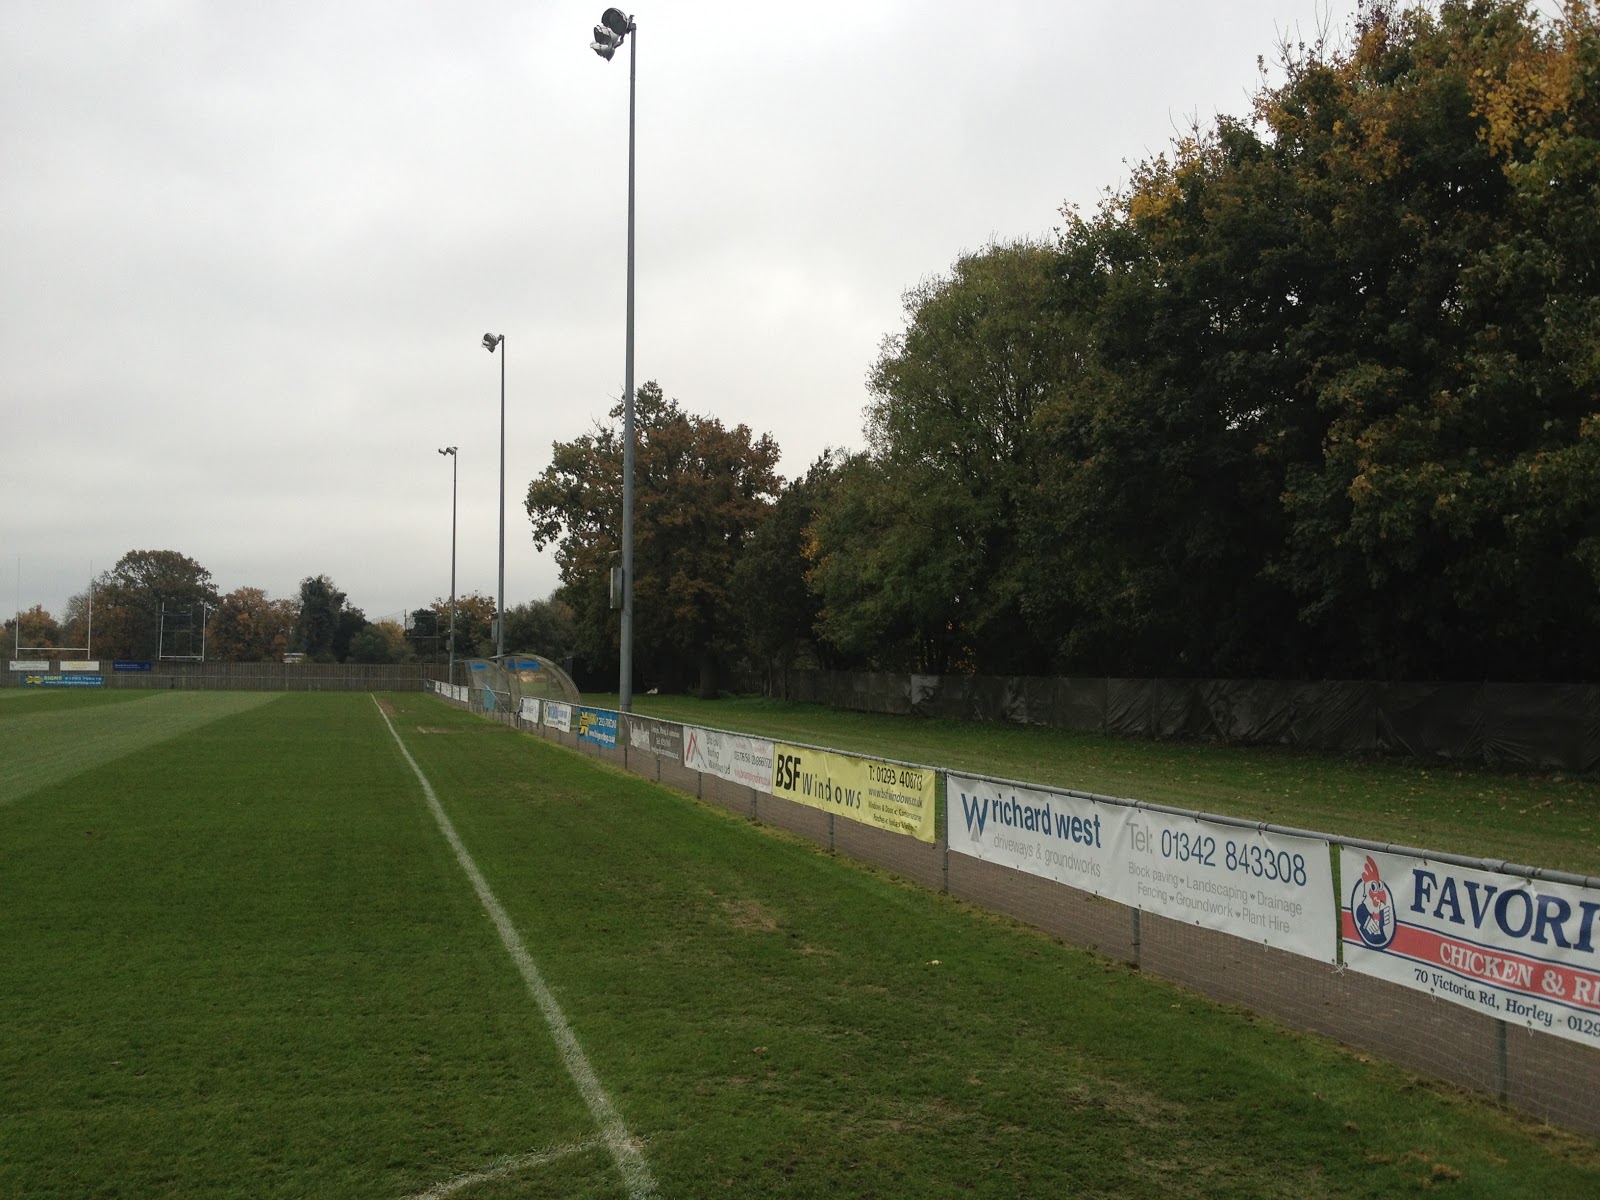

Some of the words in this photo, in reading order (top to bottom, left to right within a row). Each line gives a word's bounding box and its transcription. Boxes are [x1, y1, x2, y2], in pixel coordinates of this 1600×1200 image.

[775, 754, 801, 791] BSF
[802, 772, 862, 809] Windows
[868, 765, 875, 781] T:
[876, 767, 896, 786] 01293
[992, 794, 1052, 836] richard
[1055, 811, 1101, 849] west
[993, 833, 1034, 858] driveways
[1035, 847, 1042, 860] &
[1044, 848, 1101, 878] groundworks
[1126, 821, 1154, 855] Tel:
[1161, 829, 1216, 867] 01342
[1225, 840, 1307, 887] 843308
[1128, 861, 1151, 879] Block
[1152, 869, 1179, 888] paving
[1186, 872, 1249, 904] Landscaping
[1257, 891, 1303, 917] Drainage
[1137, 881, 1168, 904] Fencing
[1176, 891, 1234, 919] Groundwork
[1242, 908, 1266, 928] Plant
[1269, 915, 1290, 934] Hire
[1410, 868, 1600, 954] FAVORI
[1439, 942, 1535, 988] CHICKEN
[1541, 969, 1566, 997] &
[1414, 968, 1429, 984] 70
[1431, 973, 1476, 1001] Victoria
[1479, 990, 1500, 1011] Rd,
[1505, 999, 1553, 1027] Horley
